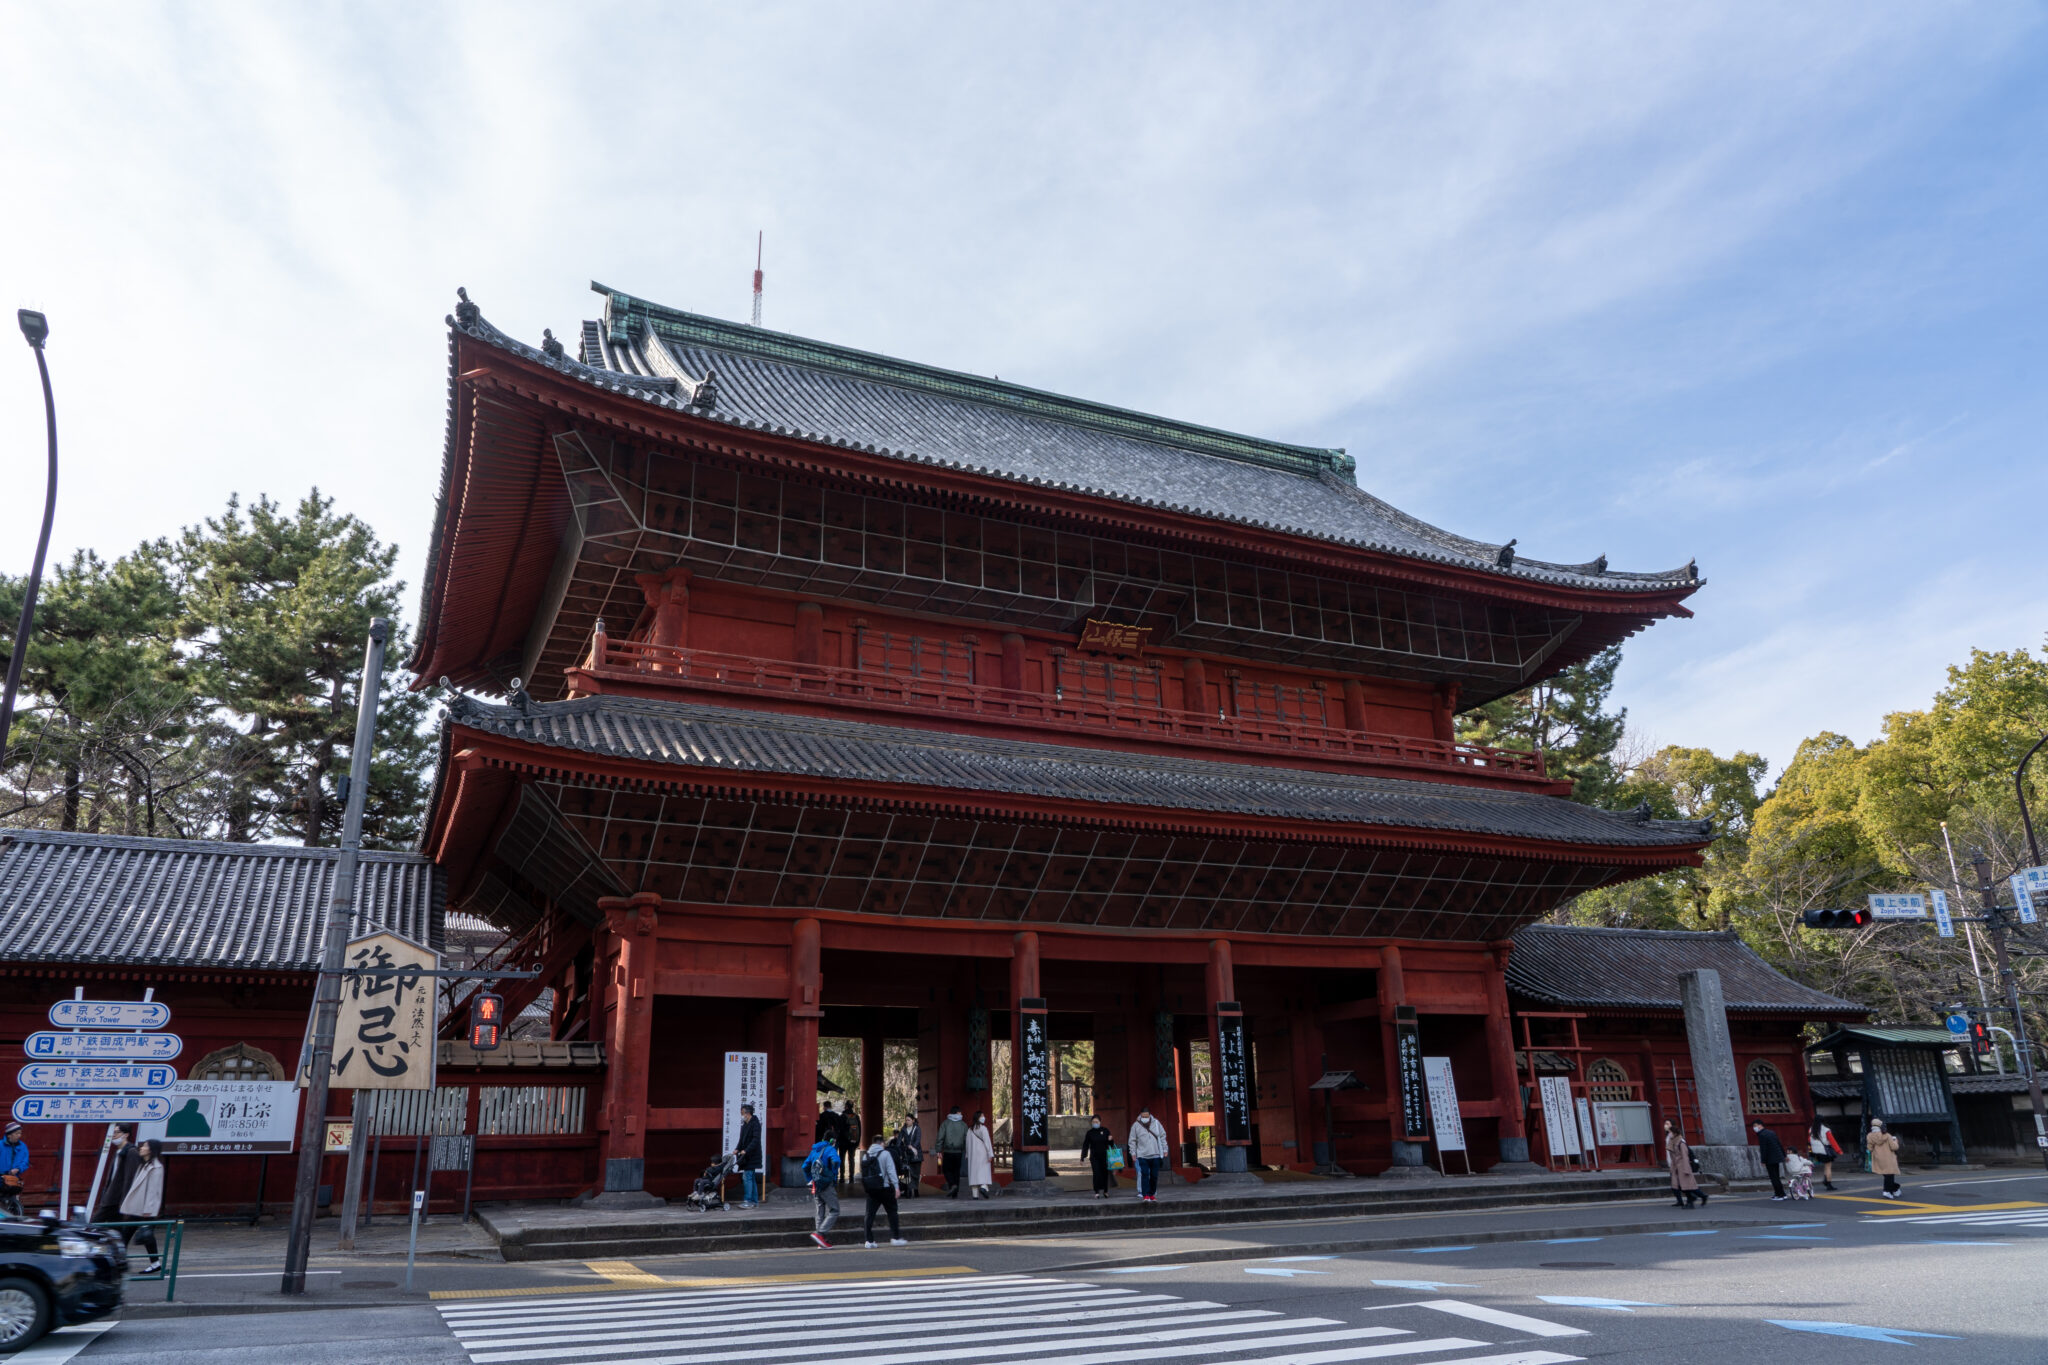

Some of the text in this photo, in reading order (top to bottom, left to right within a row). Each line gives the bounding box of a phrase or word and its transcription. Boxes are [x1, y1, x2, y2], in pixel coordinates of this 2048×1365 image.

[1874, 897, 1921, 907] 増上寺前
[60, 1005, 137, 1015] 東京タワー
[76, 1016, 120, 1024] Tokyo Tower
[61, 1036, 149, 1047] 地下鉄御成門駅
[54, 1067, 143, 1078] 地下鉄芝公園駅
[1027, 1052, 1042, 1139] 御両家結婚式
[50, 1099, 139, 1109] 地下鉄大門駅
[219, 1102, 272, 1119] 浄土宗
[217, 1119, 269, 1129] 開宗850年
